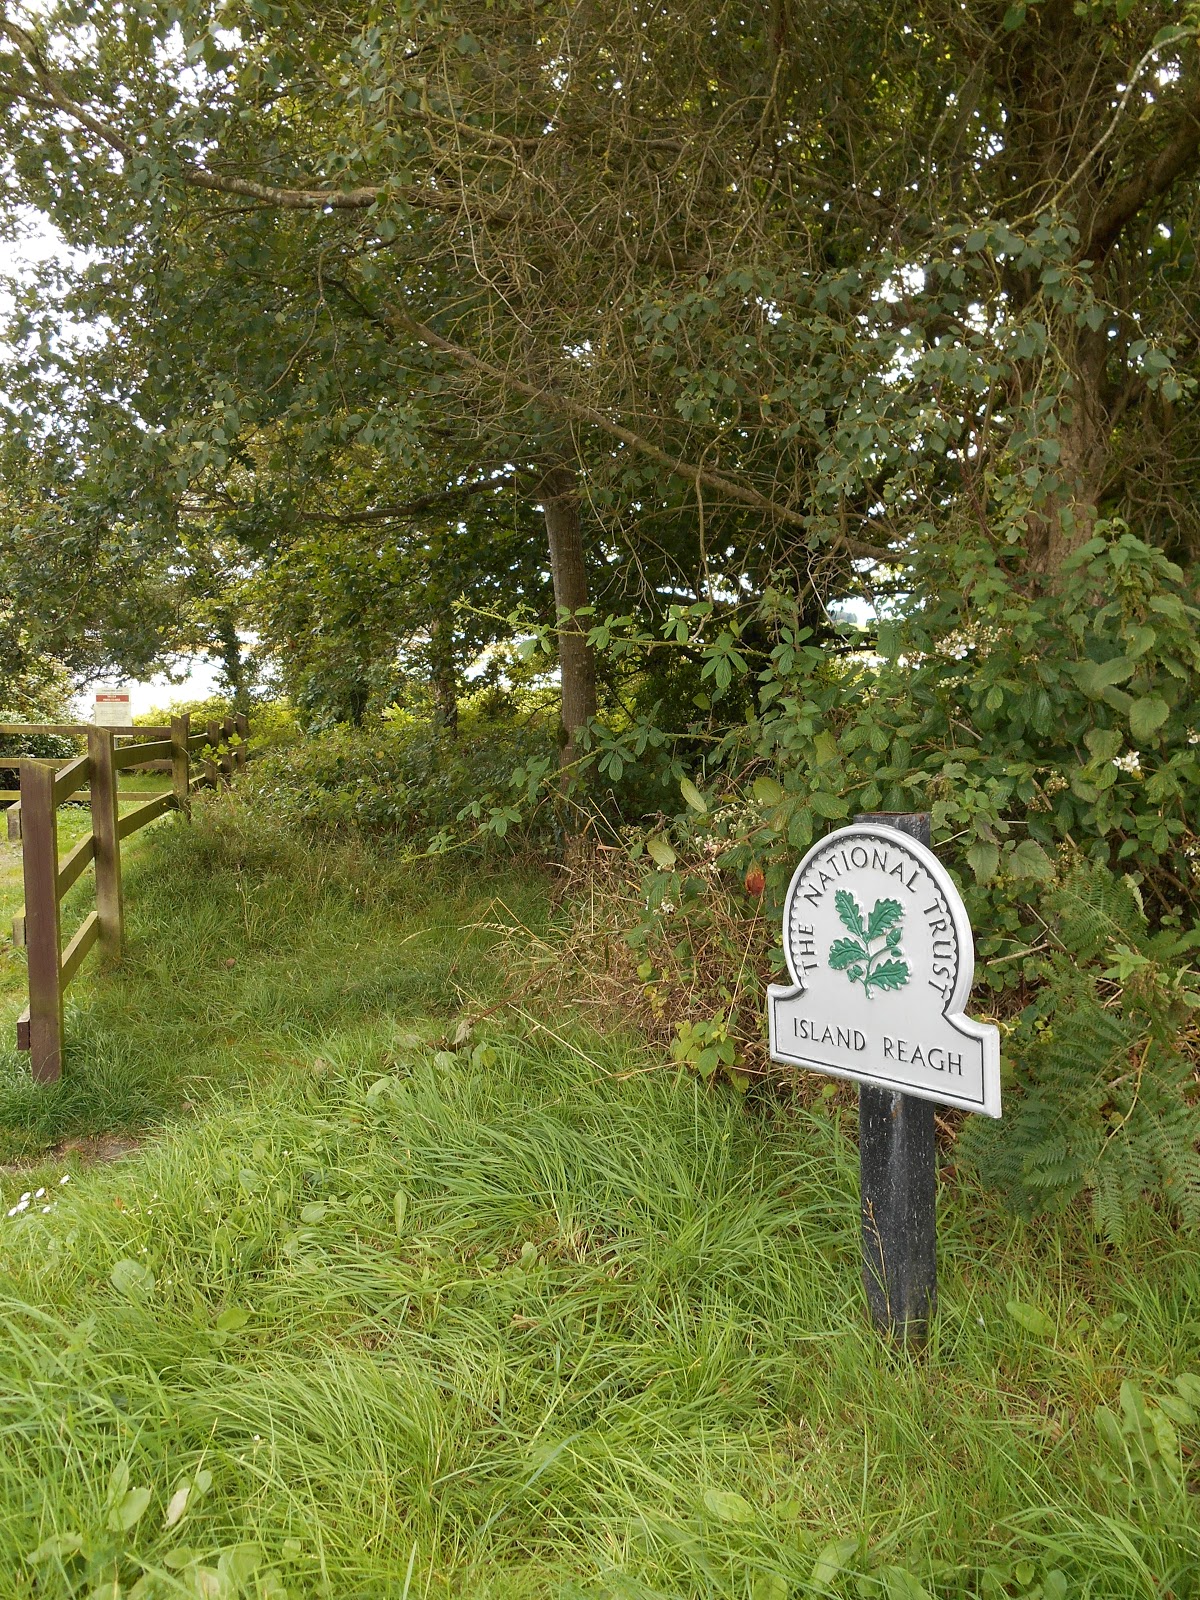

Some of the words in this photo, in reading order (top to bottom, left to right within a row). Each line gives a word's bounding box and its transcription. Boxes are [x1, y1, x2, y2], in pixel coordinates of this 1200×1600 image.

[804, 846, 921, 908] NATIONAL
[798, 922, 819, 977] THE
[923, 898, 952, 999] TRUST
[793, 1016, 866, 1051] ISLAND
[883, 1036, 963, 1076] REAGH
